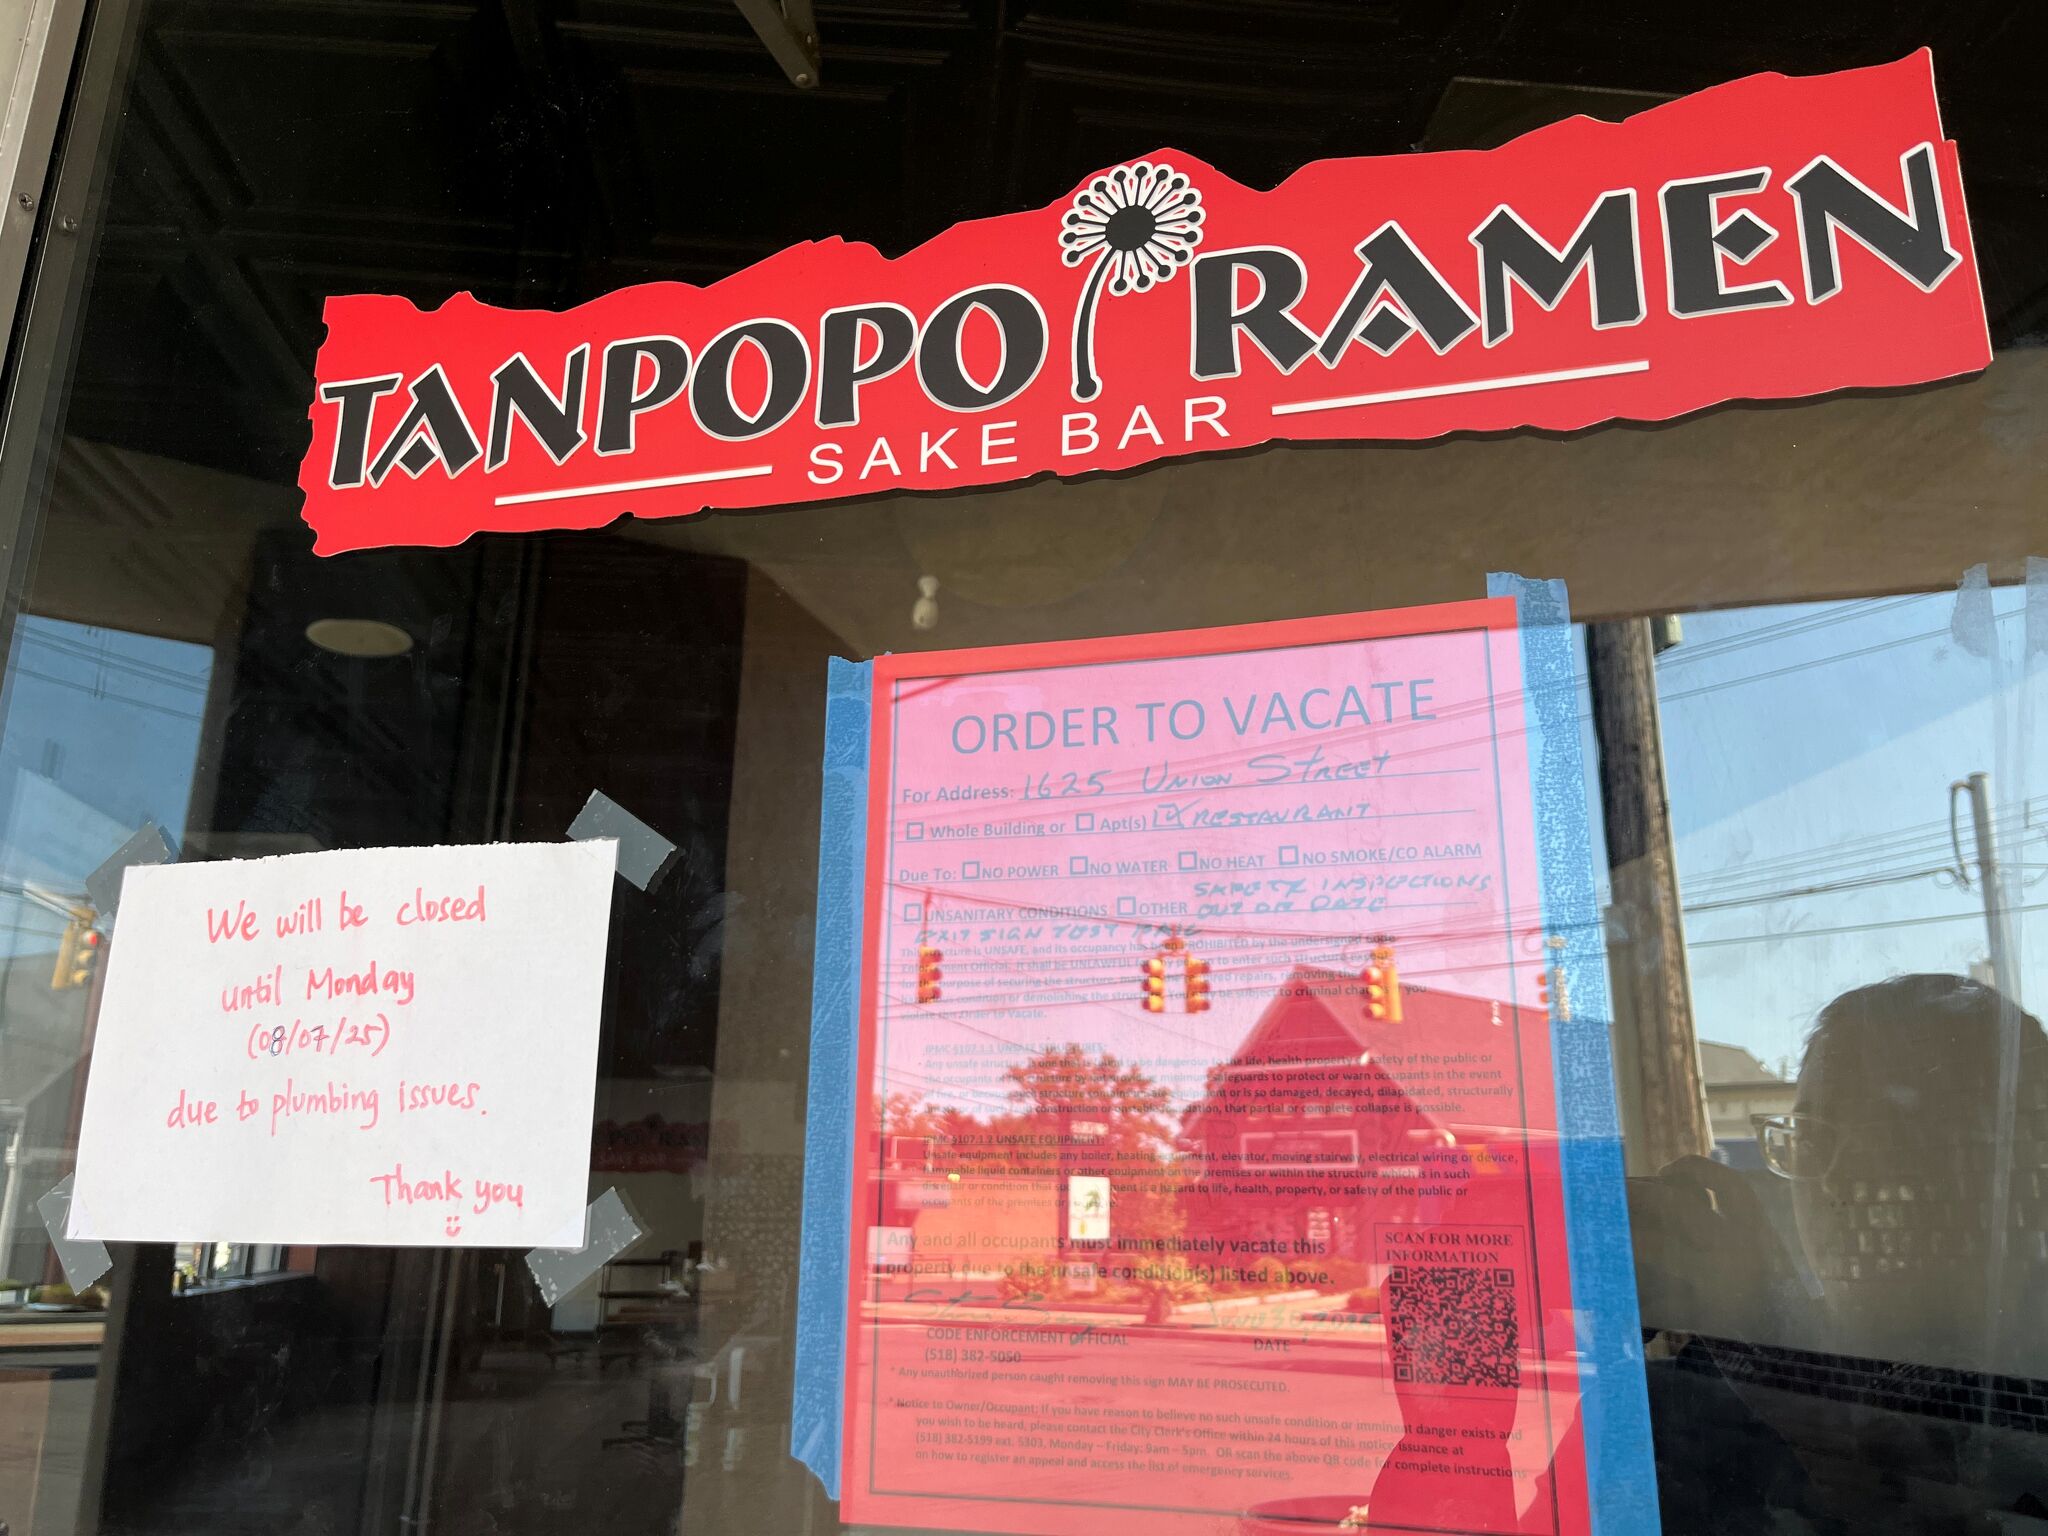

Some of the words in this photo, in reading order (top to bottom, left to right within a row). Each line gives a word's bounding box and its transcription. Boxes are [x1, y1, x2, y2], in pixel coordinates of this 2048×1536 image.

[320, 283, 1049, 490] TANPOPO
[1190, 141, 1962, 378] RAMEN
[808, 420, 1018, 485] SAKE
[1061, 394, 1231, 458] BAR
[951, 705, 1120, 755] ORDER
[1136, 699, 1206, 743] TO
[1223, 678, 1437, 737] VACATE
[903, 788, 929, 803] For
[937, 785, 1015, 802] Address:
[1022, 769, 1113, 800] 1625
[930, 824, 978, 838] Whole
[984, 822, 1045, 836] Building
[1050, 822, 1066, 833] or
[1100, 815, 1147, 832] Apt(s)
[900, 869, 928, 882] Due
[934, 868, 957, 880] To:
[982, 867, 1003, 879] NO
[1008, 865, 1058, 878] POWER
[1089, 863, 1111, 875] NO
[1116, 860, 1168, 874] WATER
[1200, 858, 1223, 870] NO
[1227, 855, 1266, 868] HEAT
[1303, 852, 1326, 865] NO
[1331, 847, 1418, 863] SMOKE/CO
[1423, 843, 1482, 858] ALARM
[207, 900, 260, 944] We
[276, 898, 322, 938] will
[341, 890, 368, 930] be
[396, 885, 487, 926] closed
[928, 909, 1014, 922] UNSANITARY
[1018, 905, 1108, 920] CONDITIONS
[1140, 902, 1188, 916] OTHER
[984, 944, 1026, 955] UNSAFE,
[1070, 943, 1127, 955] occupancy
[222, 964, 281, 1013] until
[307, 961, 414, 1005] Monday
[1279, 988, 1292, 997] to
[1295, 986, 1341, 996] criminal
[247, 1013, 390, 1059] (08/07/25)
[1268, 1055, 1299, 1064] health
[1303, 1054, 1355, 1066] property
[1421, 1053, 1440, 1063] the
[1443, 1053, 1477, 1065] public
[1272, 1072, 1284, 1080] to
[1286, 1071, 1325, 1082] protect
[1342, 1072, 1370, 1080] warn
[1374, 1071, 1430, 1082] occupants
[1447, 1070, 1465, 1079] the
[1468, 1070, 1502, 1079] event
[1270, 1087, 1322, 1100] damaged,
[1326, 1087, 1374, 1099] decayed,
[1447, 1085, 1513, 1098] structurally
[167, 1089, 218, 1129] due
[237, 1090, 259, 1122] to
[272, 1078, 380, 1137] plumbing
[399, 1081, 487, 1116] issues.
[1225, 1103, 1247, 1113] that
[1249, 1102, 1285, 1115] partial
[1288, 1105, 1299, 1113] or
[1301, 1102, 1353, 1115] complete
[1356, 1102, 1400, 1115] collapse
[1415, 1102, 1465, 1114] possible.
[996, 1135, 1036, 1145] UNSAFE
[959, 1150, 1013, 1162] equipment
[1016, 1150, 1057, 1160] includes
[1060, 1152, 1078, 1162] any
[1081, 1151, 1114, 1161] boiler,
[1117, 1151, 1157, 1163] heating
[1222, 1152, 1269, 1162] elevator,
[1272, 1153, 1312, 1164] moving
[1368, 1151, 1419, 1162] electrical
[1422, 1152, 1458, 1164] wiring
[1476, 1153, 1517, 1163] device,
[1008, 1166, 1060, 1175] containers
[1203, 1169, 1253, 1180] premises
[1255, 1170, 1267, 1178] or
[1269, 1169, 1304, 1178] within
[1307, 1169, 1325, 1178] the
[1327, 1169, 1378, 1179] structure
[1443, 1169, 1470, 1179] such
[370, 1163, 463, 1207] Thank
[474, 1183, 524, 1215] you
[1235, 1184, 1271, 1195] health,
[1275, 1185, 1325, 1197] property,
[1329, 1187, 1341, 1195] or
[1344, 1185, 1378, 1197] safety
[1382, 1185, 1394, 1195] of
[1396, 1185, 1415, 1195] the
[1418, 1186, 1453, 1198] public
[1456, 1188, 1467, 1196] or
[886, 1232, 917, 1250] Any
[927, 1232, 954, 1247] and
[958, 1232, 979, 1247] all
[983, 1234, 1065, 1252] occupants
[1070, 1238, 1115, 1250] must
[1118, 1236, 1225, 1256] immediately
[1230, 1240, 1288, 1254] vacate
[1292, 1237, 1326, 1254] this
[1385, 1232, 1425, 1245] SCAN
[1429, 1232, 1465, 1245] FOR
[1470, 1233, 1513, 1246] MORE
[1386, 1250, 1499, 1263] INFORMATION
[886, 1263, 956, 1280] property
[961, 1261, 990, 1275] due
[998, 1264, 1013, 1276] to
[1019, 1262, 1045, 1277] the
[1051, 1261, 1107, 1278] unsafe
[1112, 1262, 1216, 1283] condition(s)
[1220, 1266, 1268, 1283] listed
[1273, 1267, 1335, 1285] above.
[927, 1327, 960, 1340] CODE
[966, 1328, 1064, 1343] ENFORCEMENT
[1069, 1331, 1128, 1345] OFFICIAL
[1254, 1339, 1290, 1352] DATE
[925, 1348, 957, 1363] (518)
[962, 1350, 1022, 1363] 382-5050
[899, 1367, 918, 1379] Any
[921, 1367, 989, 1380] unauthorized
[991, 1372, 1027, 1383] person
[1030, 1372, 1063, 1384] caught
[1067, 1374, 1117, 1386] removing
[1121, 1374, 1142, 1385] this
[1144, 1376, 1165, 1388] sign
[1168, 1377, 1194, 1388] MAY
[1197, 1379, 1211, 1388] BE
[1213, 1379, 1290, 1392] PROSECUTED.
[896, 1398, 928, 1410] Notice
[1051, 1407, 1071, 1417] you
[1074, 1406, 1100, 1416] have
[1103, 1408, 1139, 1418] reason
[1156, 1409, 1197, 1420] believe
[1417, 1424, 1457, 1439] danger
[1461, 1427, 1495, 1440] exists
[1499, 1430, 1522, 1441] and
[1452, 1446, 1464, 1455] at
[1395, 1460, 1450, 1475] complete
[1454, 1464, 1527, 1478] instructions
